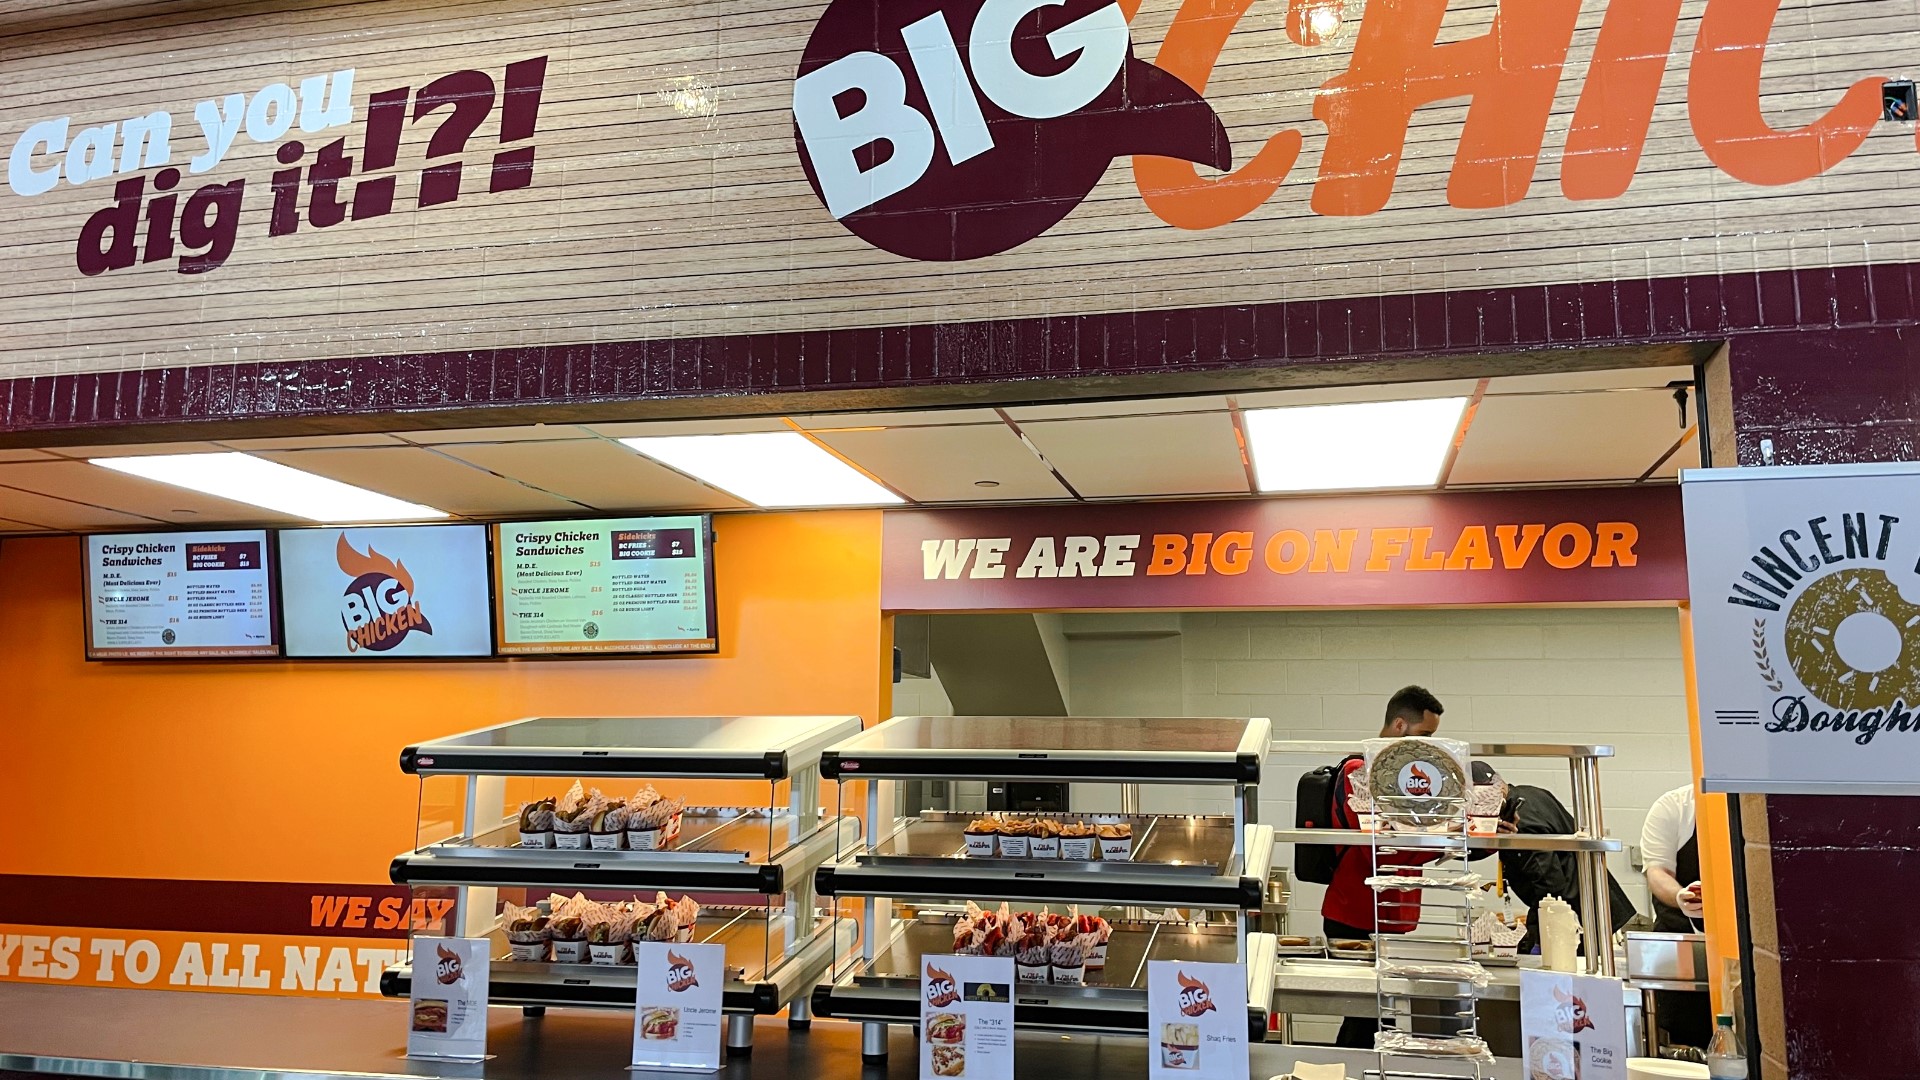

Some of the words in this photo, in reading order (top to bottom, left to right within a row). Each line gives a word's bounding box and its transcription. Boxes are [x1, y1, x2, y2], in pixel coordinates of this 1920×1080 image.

[793, 0, 1130, 220] BIG
[1118, 0, 1920, 230] CHIC
[8, 110, 174, 196] Can
[189, 68, 356, 173] you
[76, 167, 246, 276] dig
[516, 533, 552, 544] Crispy
[554, 531, 600, 542] Chicken
[102, 544, 134, 555] Crispy
[136, 543, 176, 554] Chicken
[516, 545, 584, 556] Sandwiches
[921, 536, 1012, 580] WE
[1015, 535, 1142, 579] ARE
[1146, 531, 1255, 576] BIG
[1264, 528, 1359, 574] ON
[1365, 522, 1640, 572] FLAVOR
[102, 556, 162, 567] Sandwiches
[1727, 512, 1900, 612] VINCENT
[341, 578, 410, 631] BIG
[347, 600, 423, 653] CHICKEN
[1407, 778, 1429, 788] BIG
[311, 896, 372, 928] WE
[374, 897, 455, 930] SAY
[90, 938, 161, 984] TO
[169, 942, 271, 989] ALL
[437, 959, 460, 977] BIG
[668, 966, 692, 984] BIG
[928, 980, 954, 1000] BIG
[1180, 988, 1208, 1008] BIG
[1555, 1005, 1586, 1024] BIG
[1592, 1056, 1612, 1064] Cookie
[1603, 1048, 1613, 1057] Big
